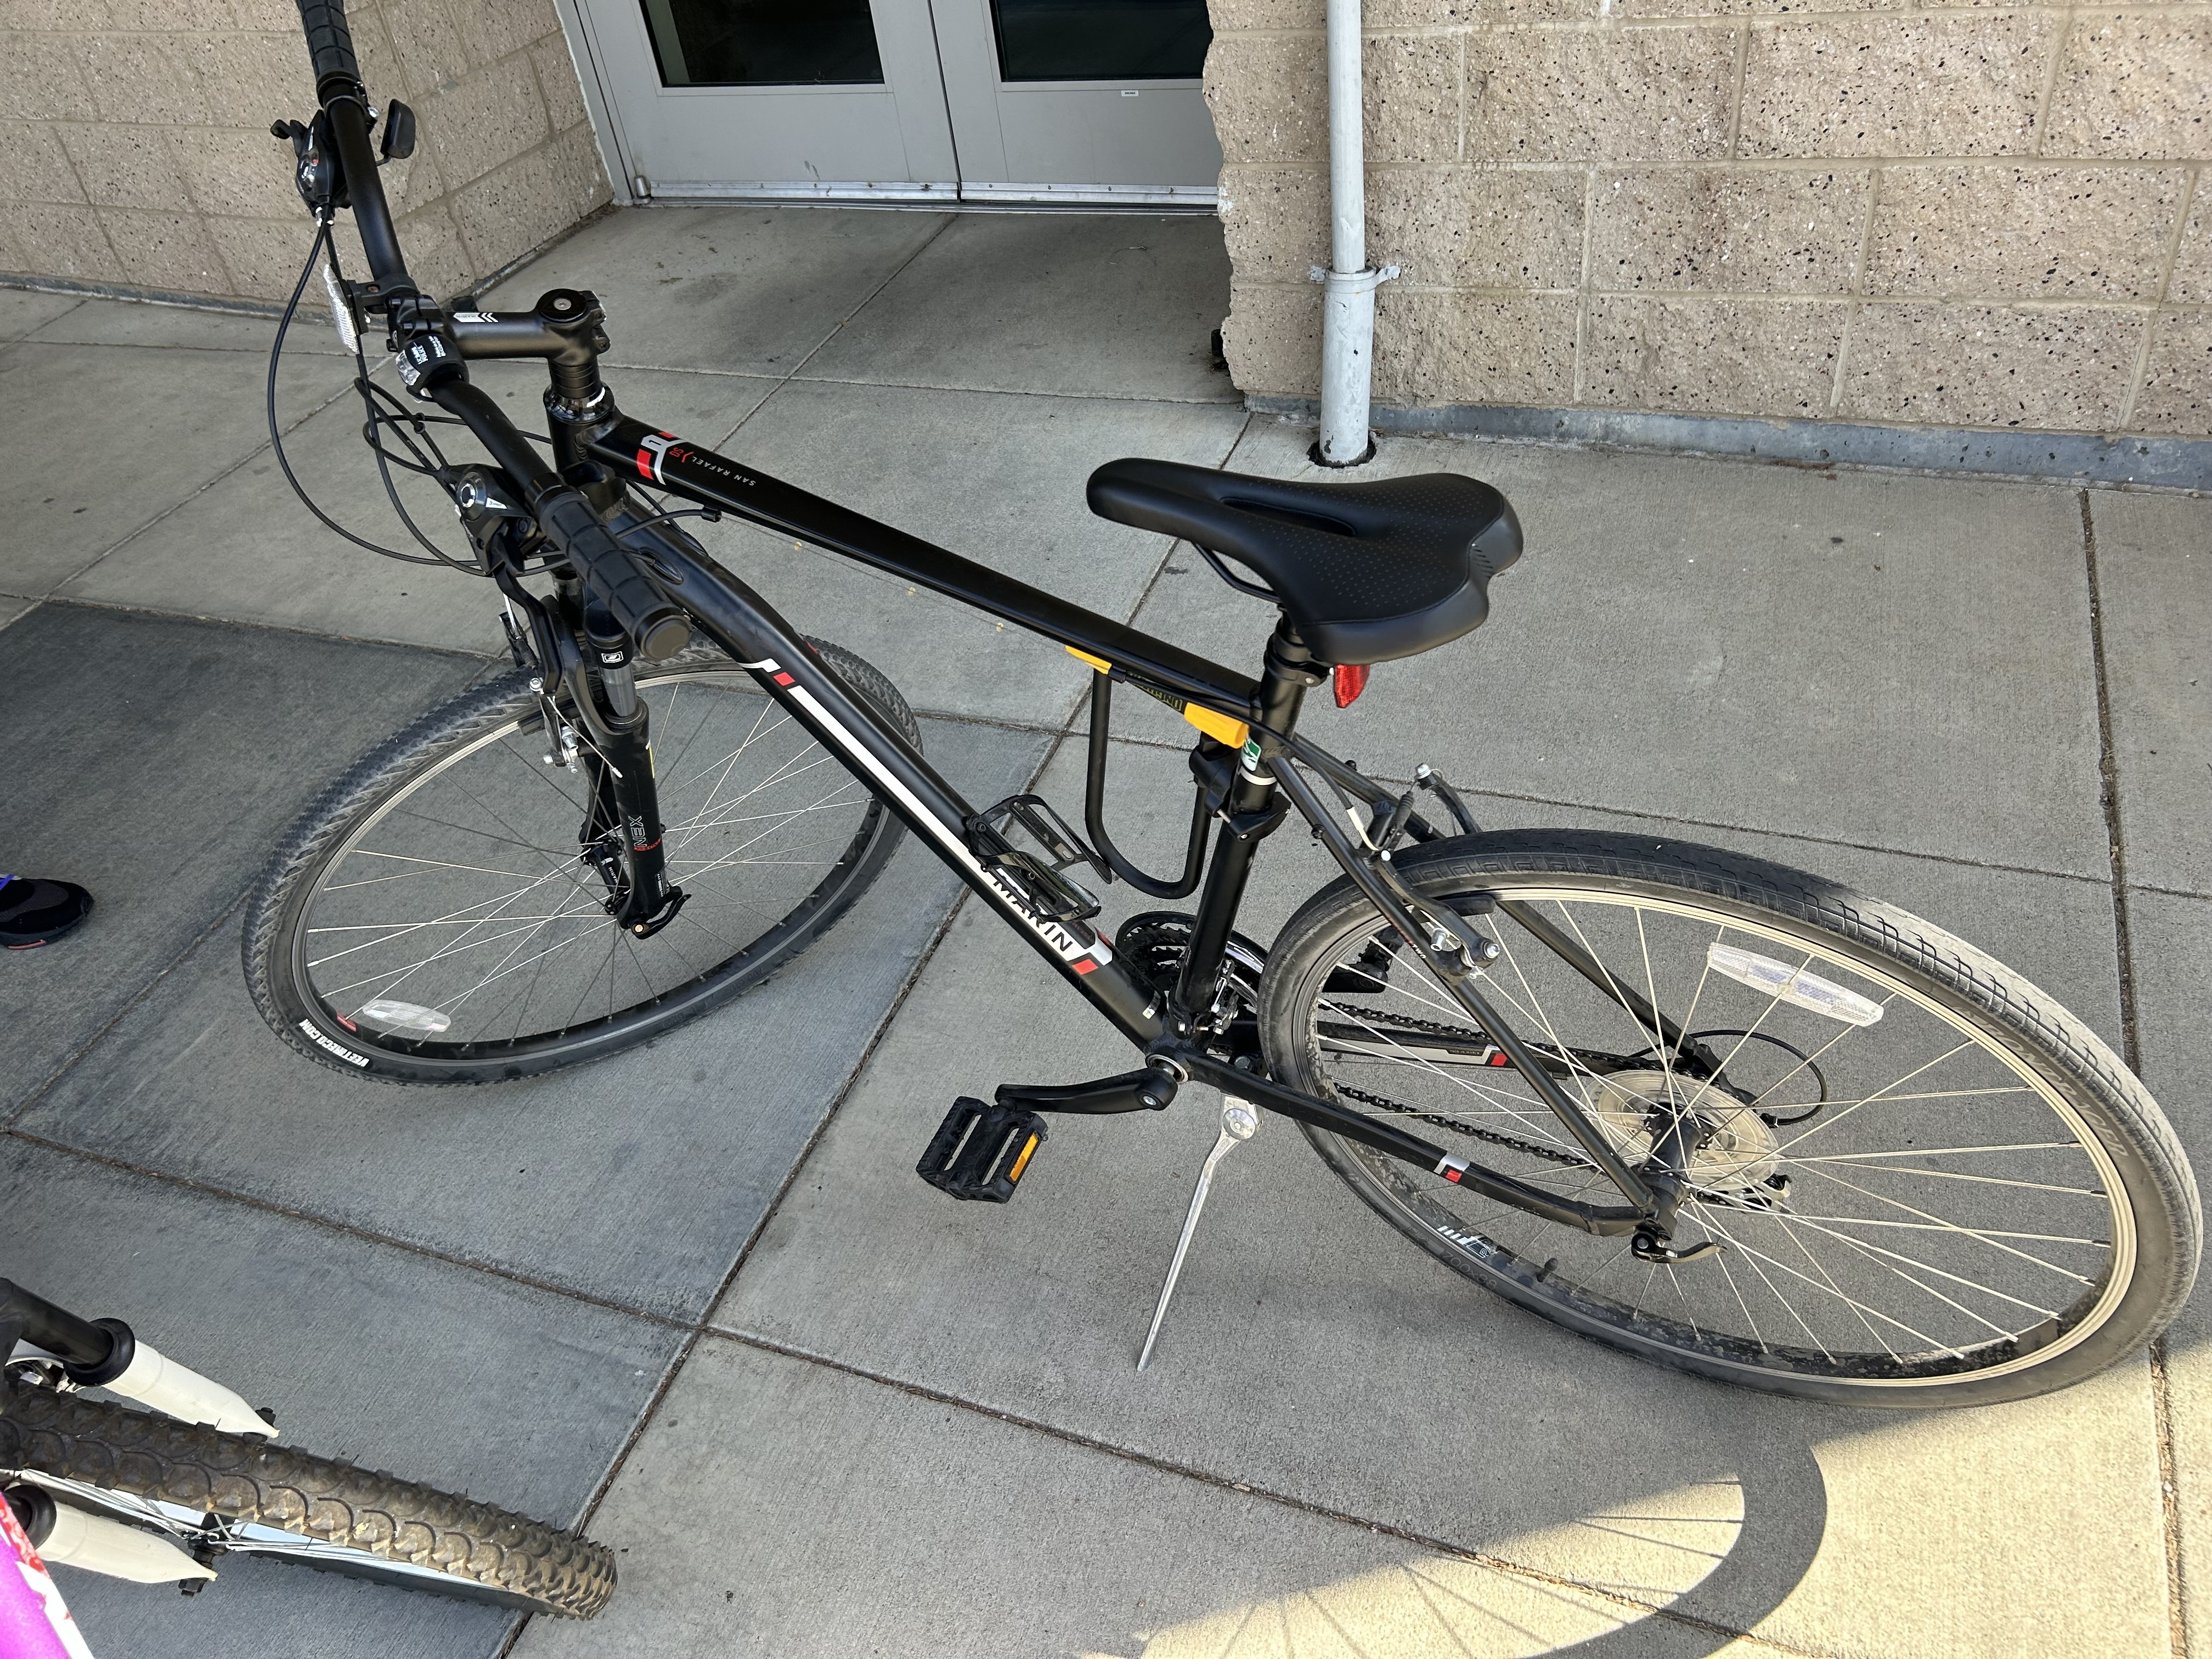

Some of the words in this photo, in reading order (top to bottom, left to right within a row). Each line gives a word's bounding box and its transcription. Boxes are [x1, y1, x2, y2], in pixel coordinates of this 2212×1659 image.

[692, 455, 731, 476] RAFAEL
[733, 475, 757, 487] SAN
[628, 815, 648, 848] NEX
[1412, 944, 1426, 958] TWO
[299, 1018, 370, 1067] VEETIRECO.COM
[1976, 1017, 2129, 1156] BONTRAGER
